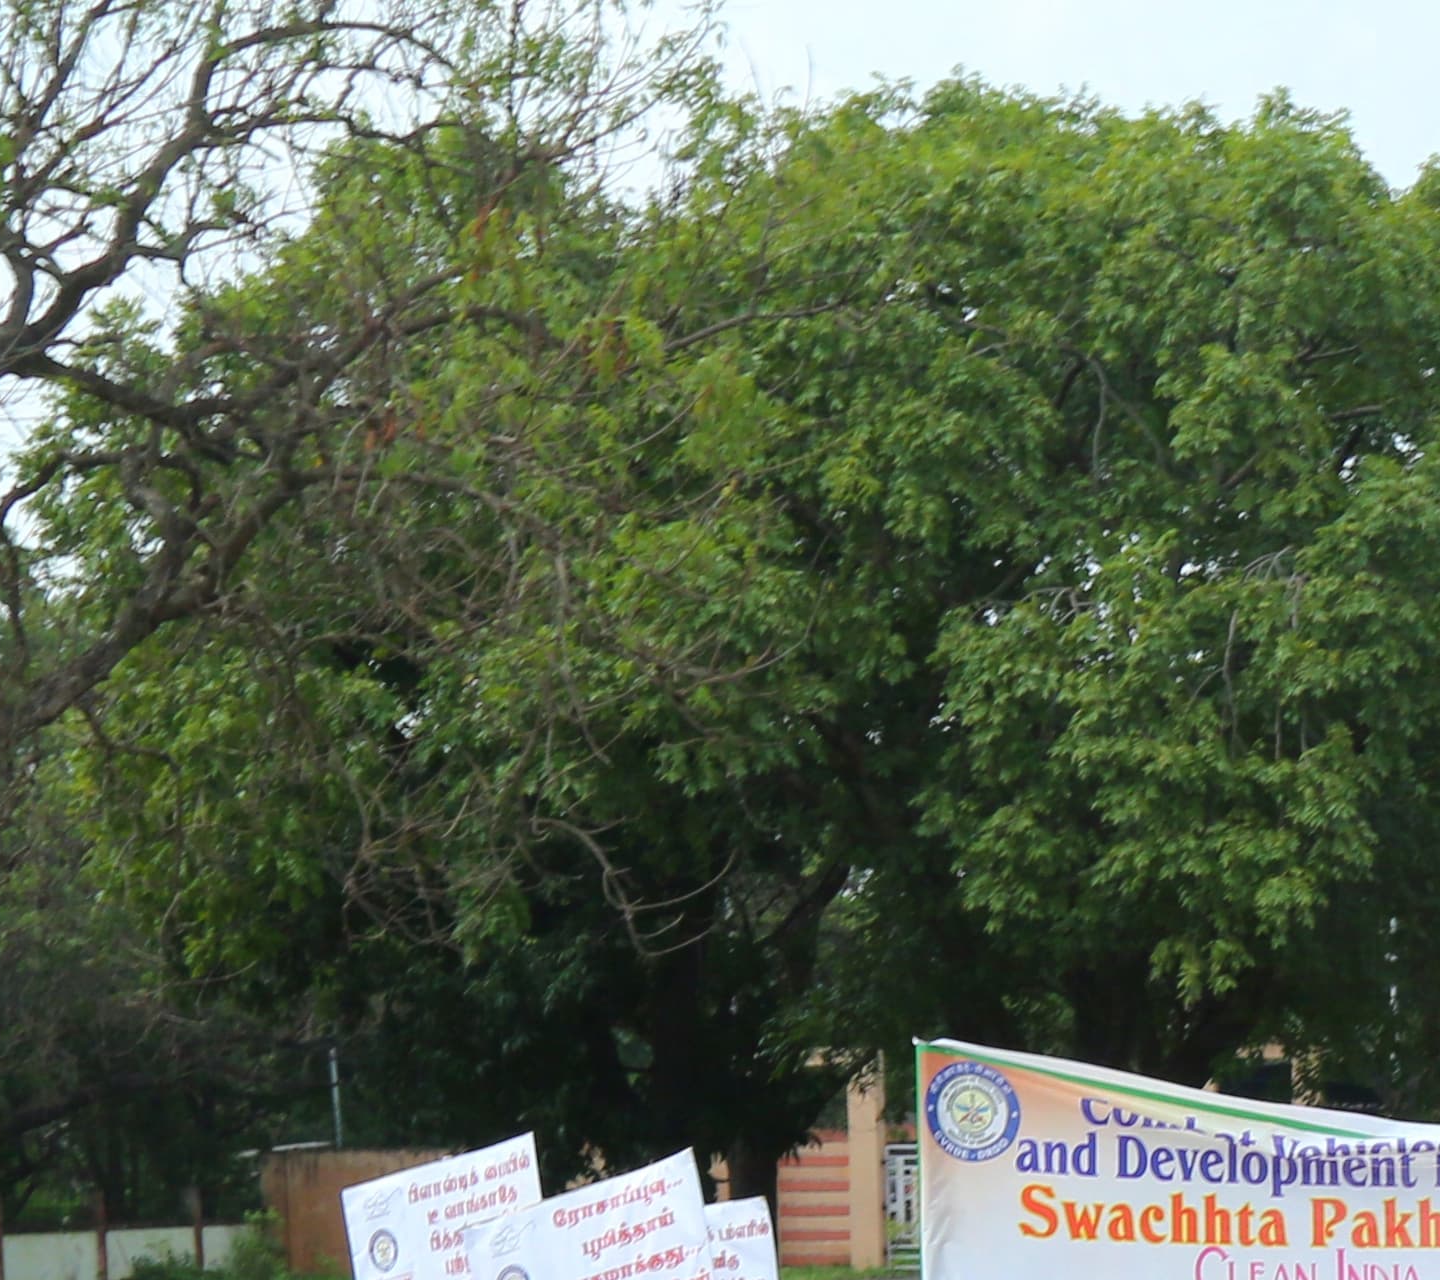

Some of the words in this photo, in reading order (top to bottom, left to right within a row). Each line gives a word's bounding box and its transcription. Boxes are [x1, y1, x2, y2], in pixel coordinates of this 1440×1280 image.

[1016, 1132, 1098, 1178] and
[1116, 1135, 1418, 1197] Development
[1018, 1183, 1289, 1247] Swachhta
